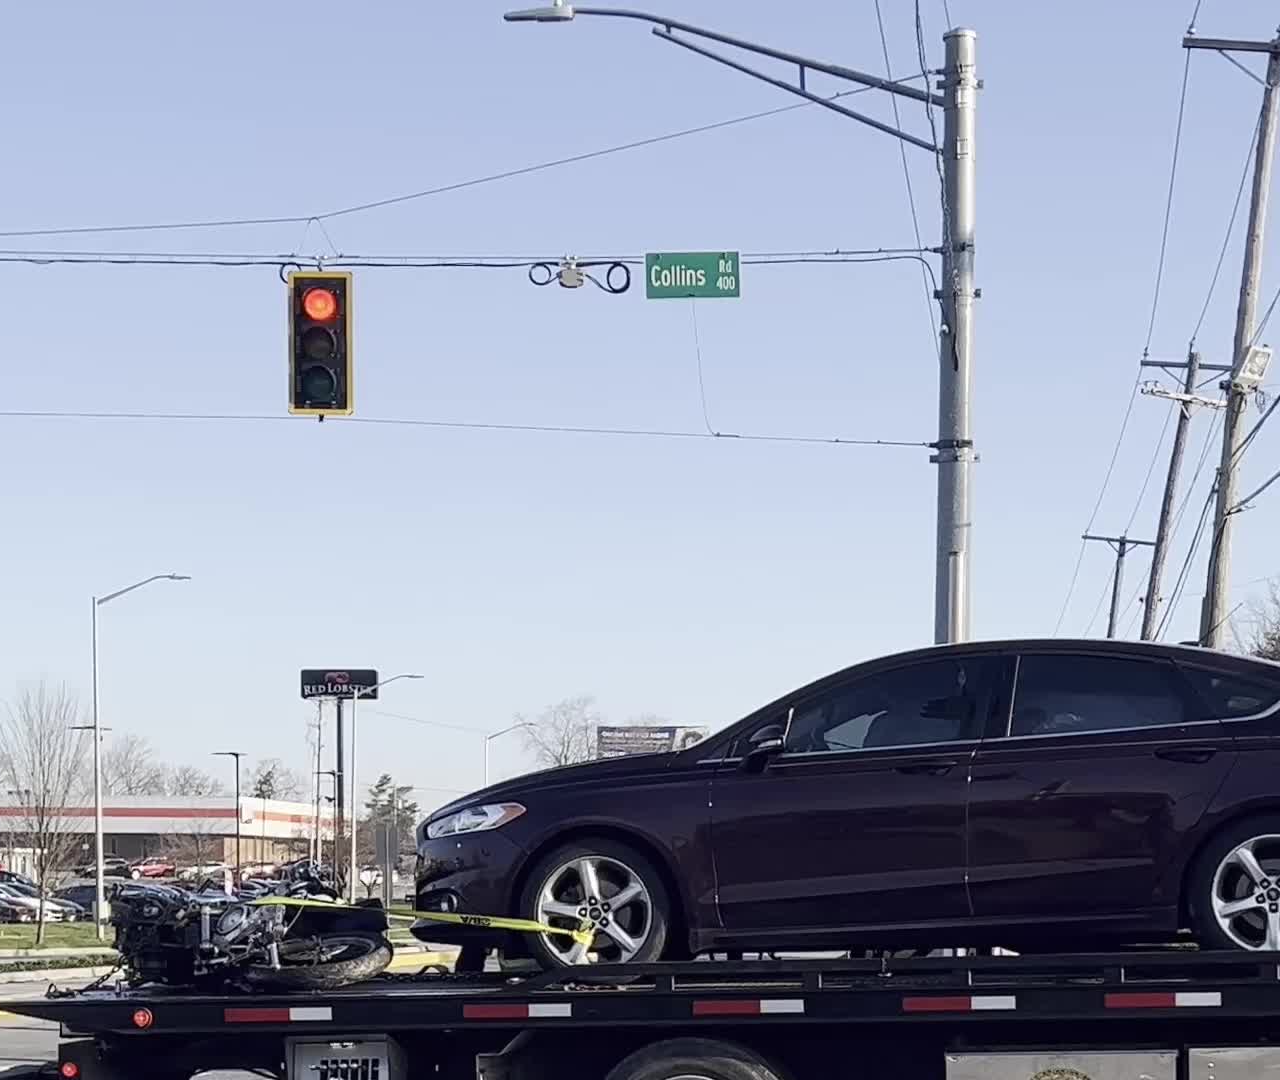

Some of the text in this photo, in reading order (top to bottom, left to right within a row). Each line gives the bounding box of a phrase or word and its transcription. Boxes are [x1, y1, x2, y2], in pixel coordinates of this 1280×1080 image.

[719, 259, 732, 273] Rd
[650, 264, 706, 287] Collins
[716, 275, 736, 290] 400
[303, 682, 374, 695] RED LOBSTE
